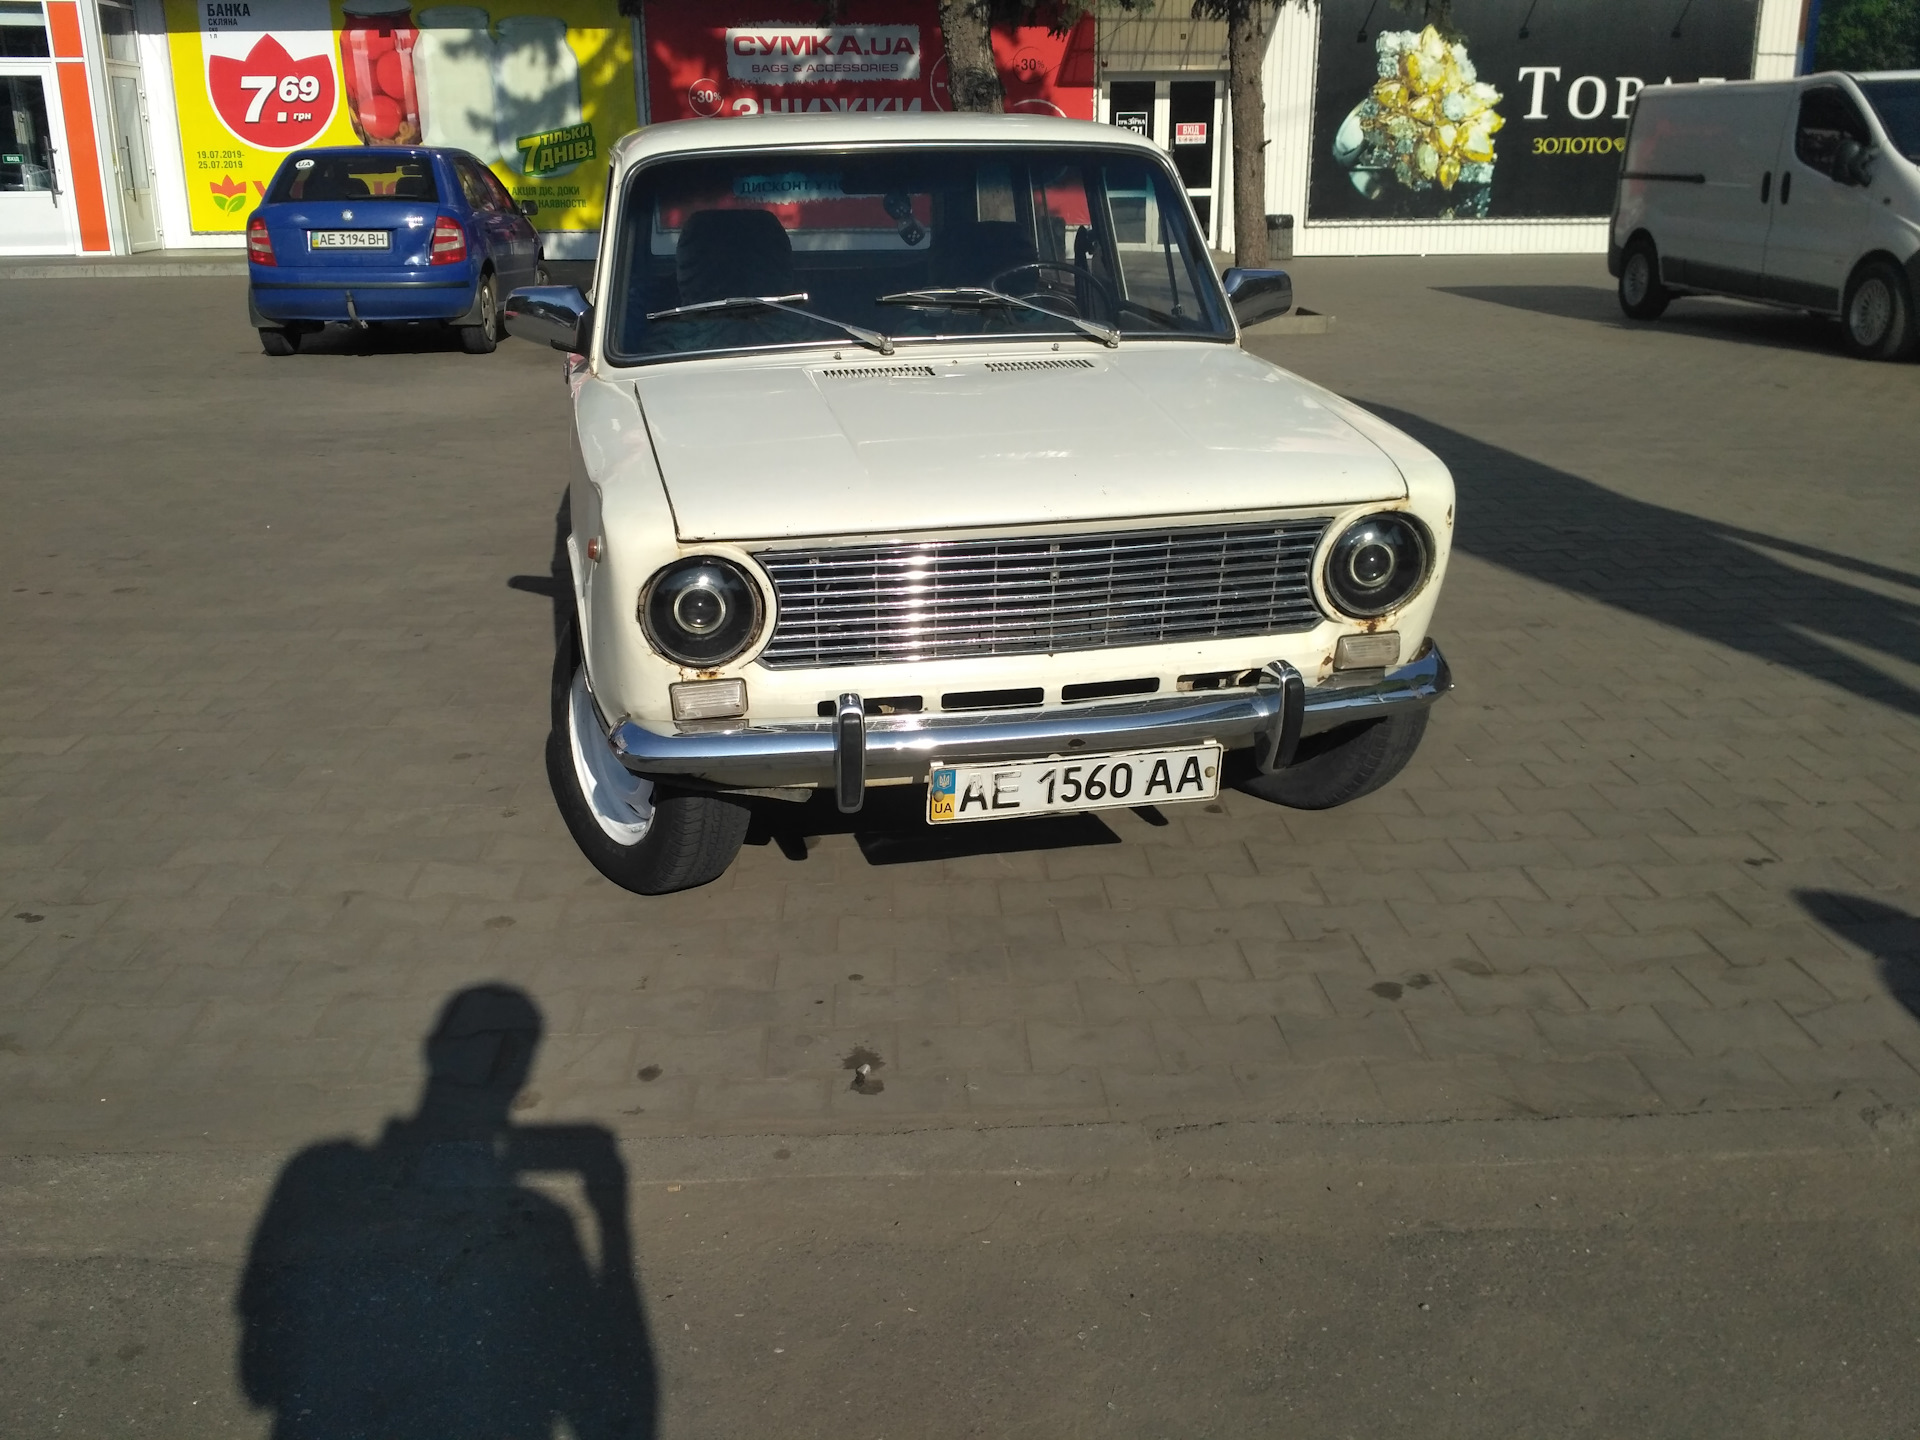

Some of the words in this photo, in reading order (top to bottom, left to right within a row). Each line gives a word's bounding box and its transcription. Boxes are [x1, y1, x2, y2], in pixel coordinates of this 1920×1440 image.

[206, 3, 251, 17] БАНКА
[207, 18, 238, 26] СКЛЯНА
[732, 35, 915, 57] СУМКА.UA
[751, 64, 789, 73] BAGS
[792, 63, 803, 73] &
[807, 62, 899, 73] ACCESSORIES
[1015, 58, 1045, 71] -30%
[691, 89, 722, 104] -30%
[293, 112, 312, 122] грн
[540, 125, 590, 146] ТІЛЬКИ
[1182, 124, 1200, 135] ВХІД
[1531, 136, 1613, 154] ЗОЛОТО
[519, 135, 541, 173] 7
[540, 139, 594, 171] ДНІВ!
[198, 160, 243, 169] 25.07.2019
[557, 186, 580, 197] ДОКИ
[319, 234, 336, 245] AE
[339, 233, 366, 245] 3194
[368, 233, 385, 245] BH
[959, 771, 1021, 812] AE
[1036, 762, 1133, 804] 1560
[1144, 756, 1205, 795] AA
[934, 803, 953, 814] UA
